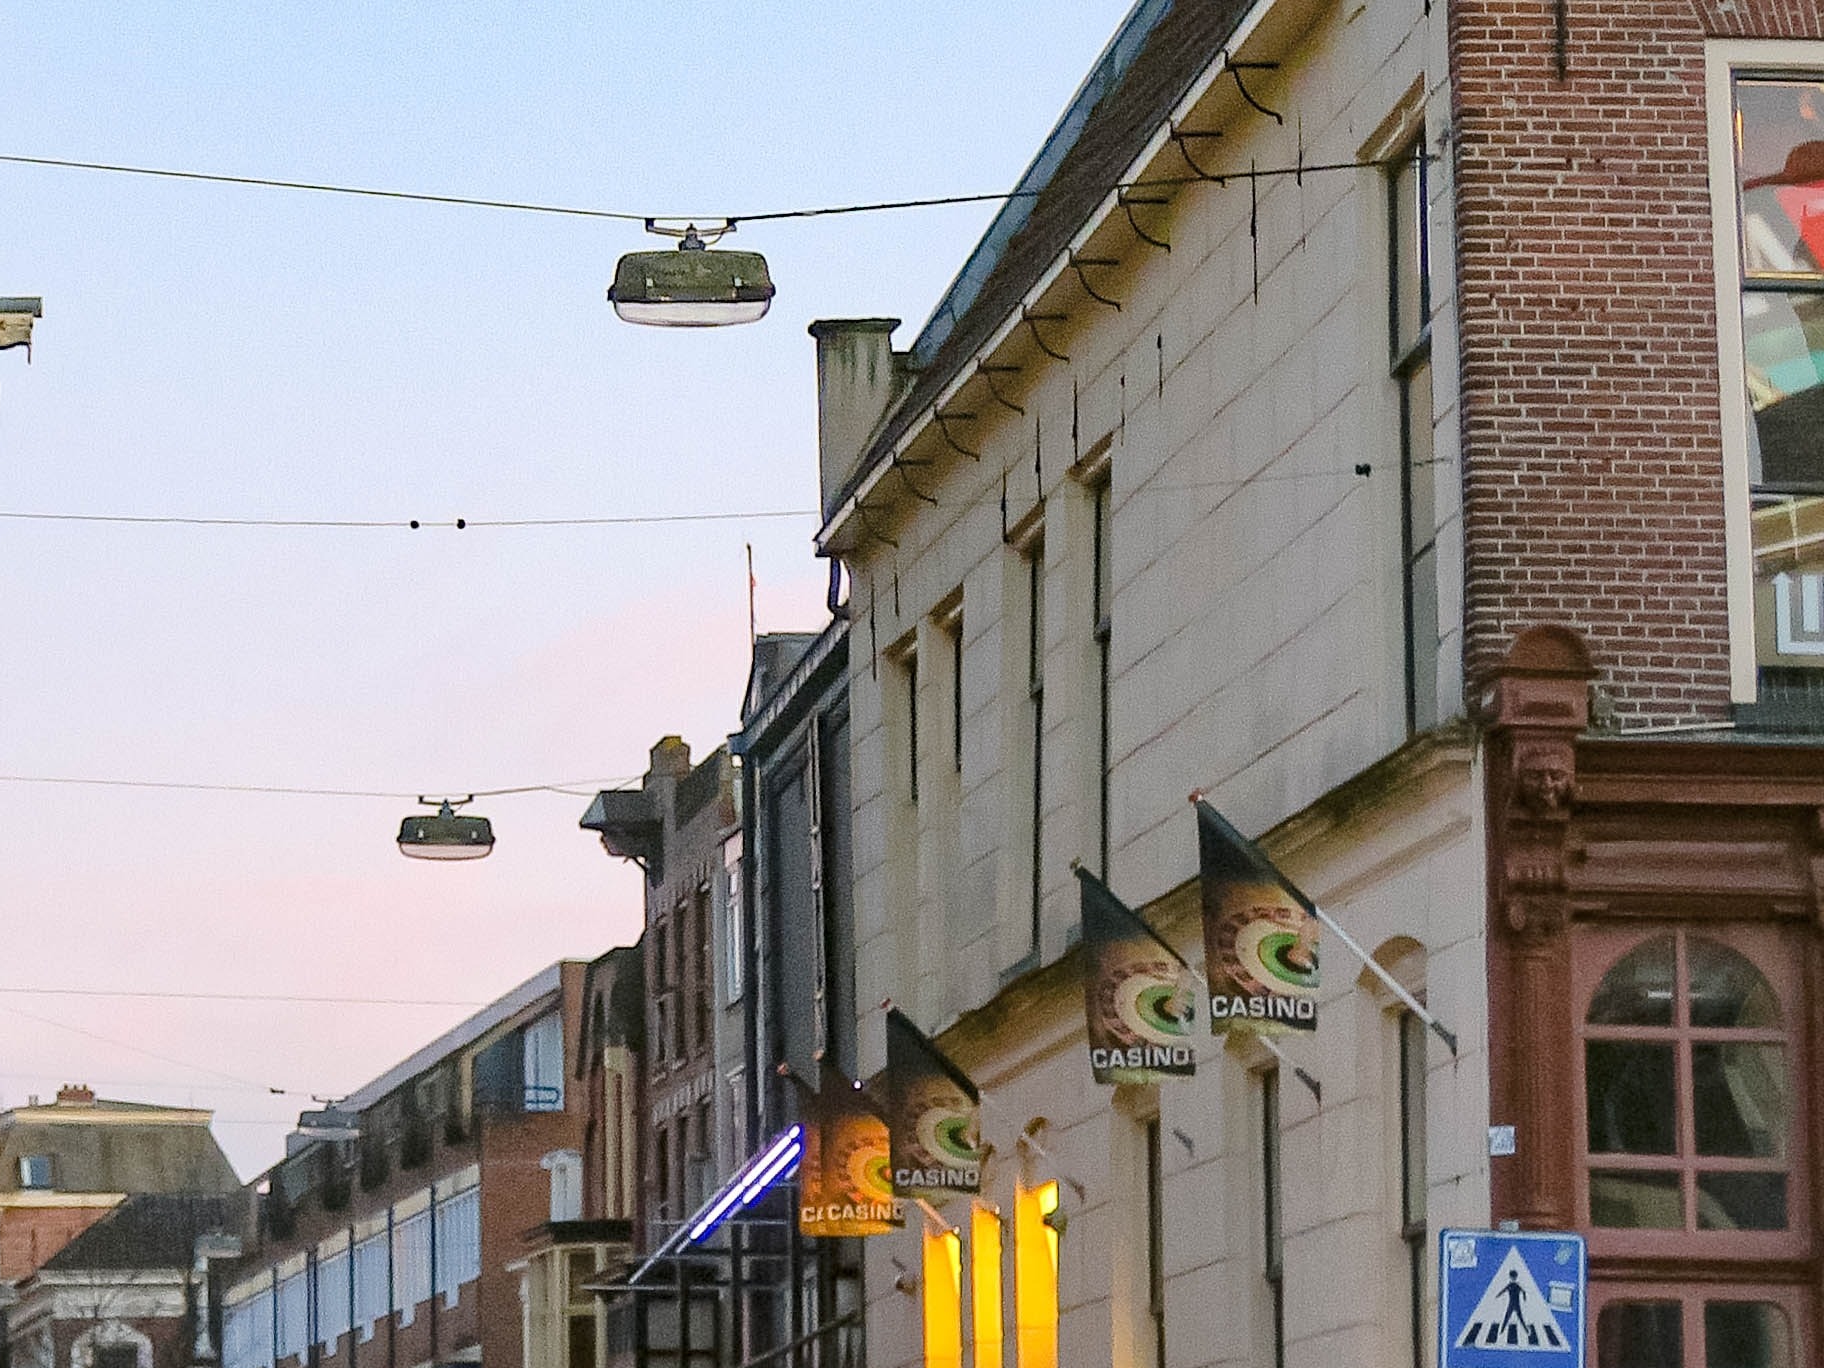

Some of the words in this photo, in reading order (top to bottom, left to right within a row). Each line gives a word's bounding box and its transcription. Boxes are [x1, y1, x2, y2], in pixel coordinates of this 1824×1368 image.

[1211, 995, 1315, 1020] CASINO
[1092, 1047, 1190, 1069] CASINO
[895, 1167, 978, 1188] CASINO
[827, 1201, 905, 1221] CASINO
